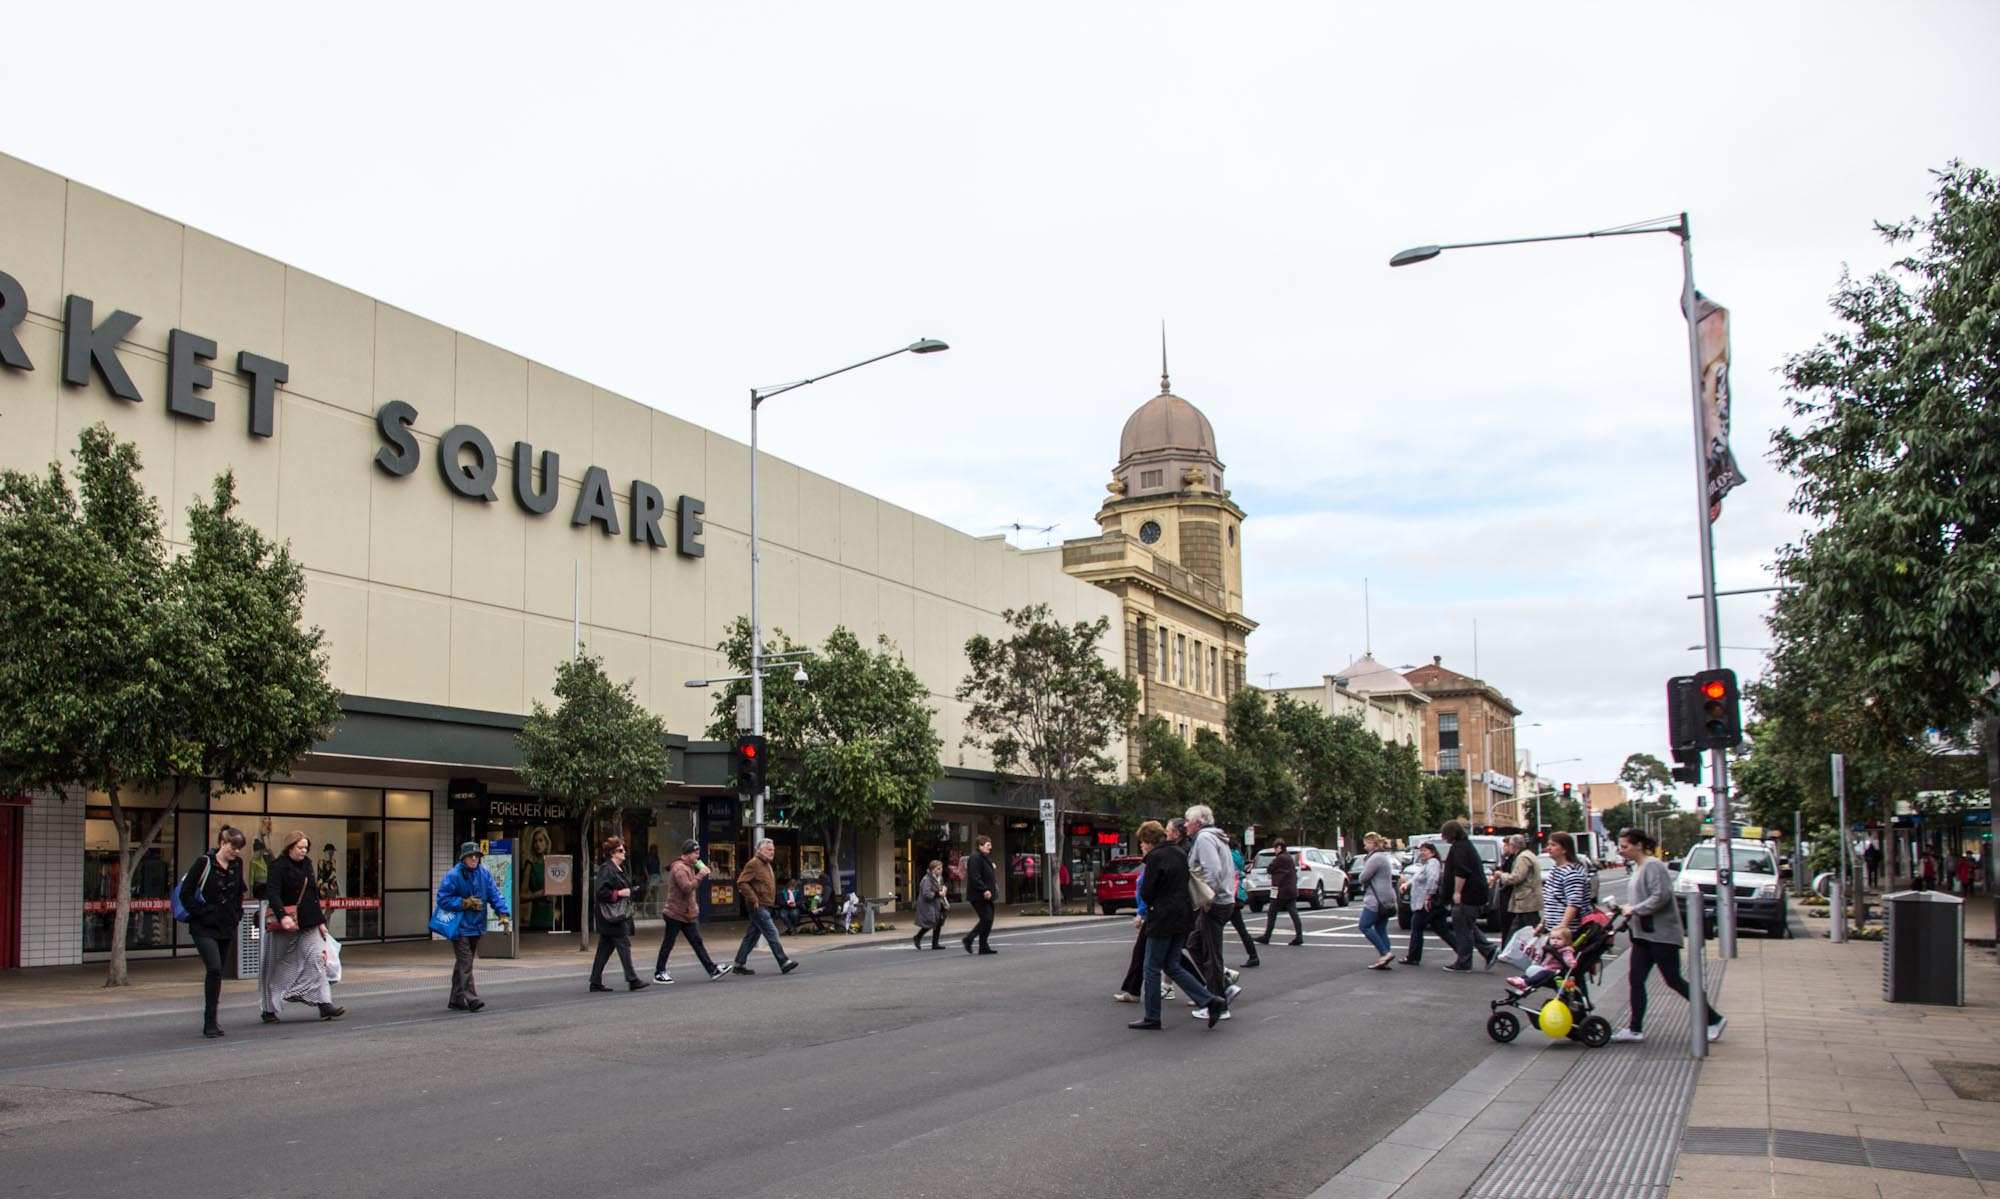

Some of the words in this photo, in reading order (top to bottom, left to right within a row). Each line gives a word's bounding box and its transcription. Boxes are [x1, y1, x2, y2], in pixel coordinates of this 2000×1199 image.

[375, 400, 705, 558] SQUARE
[490, 801, 541, 817] FOREVER
[544, 804, 566, 818] NEW
